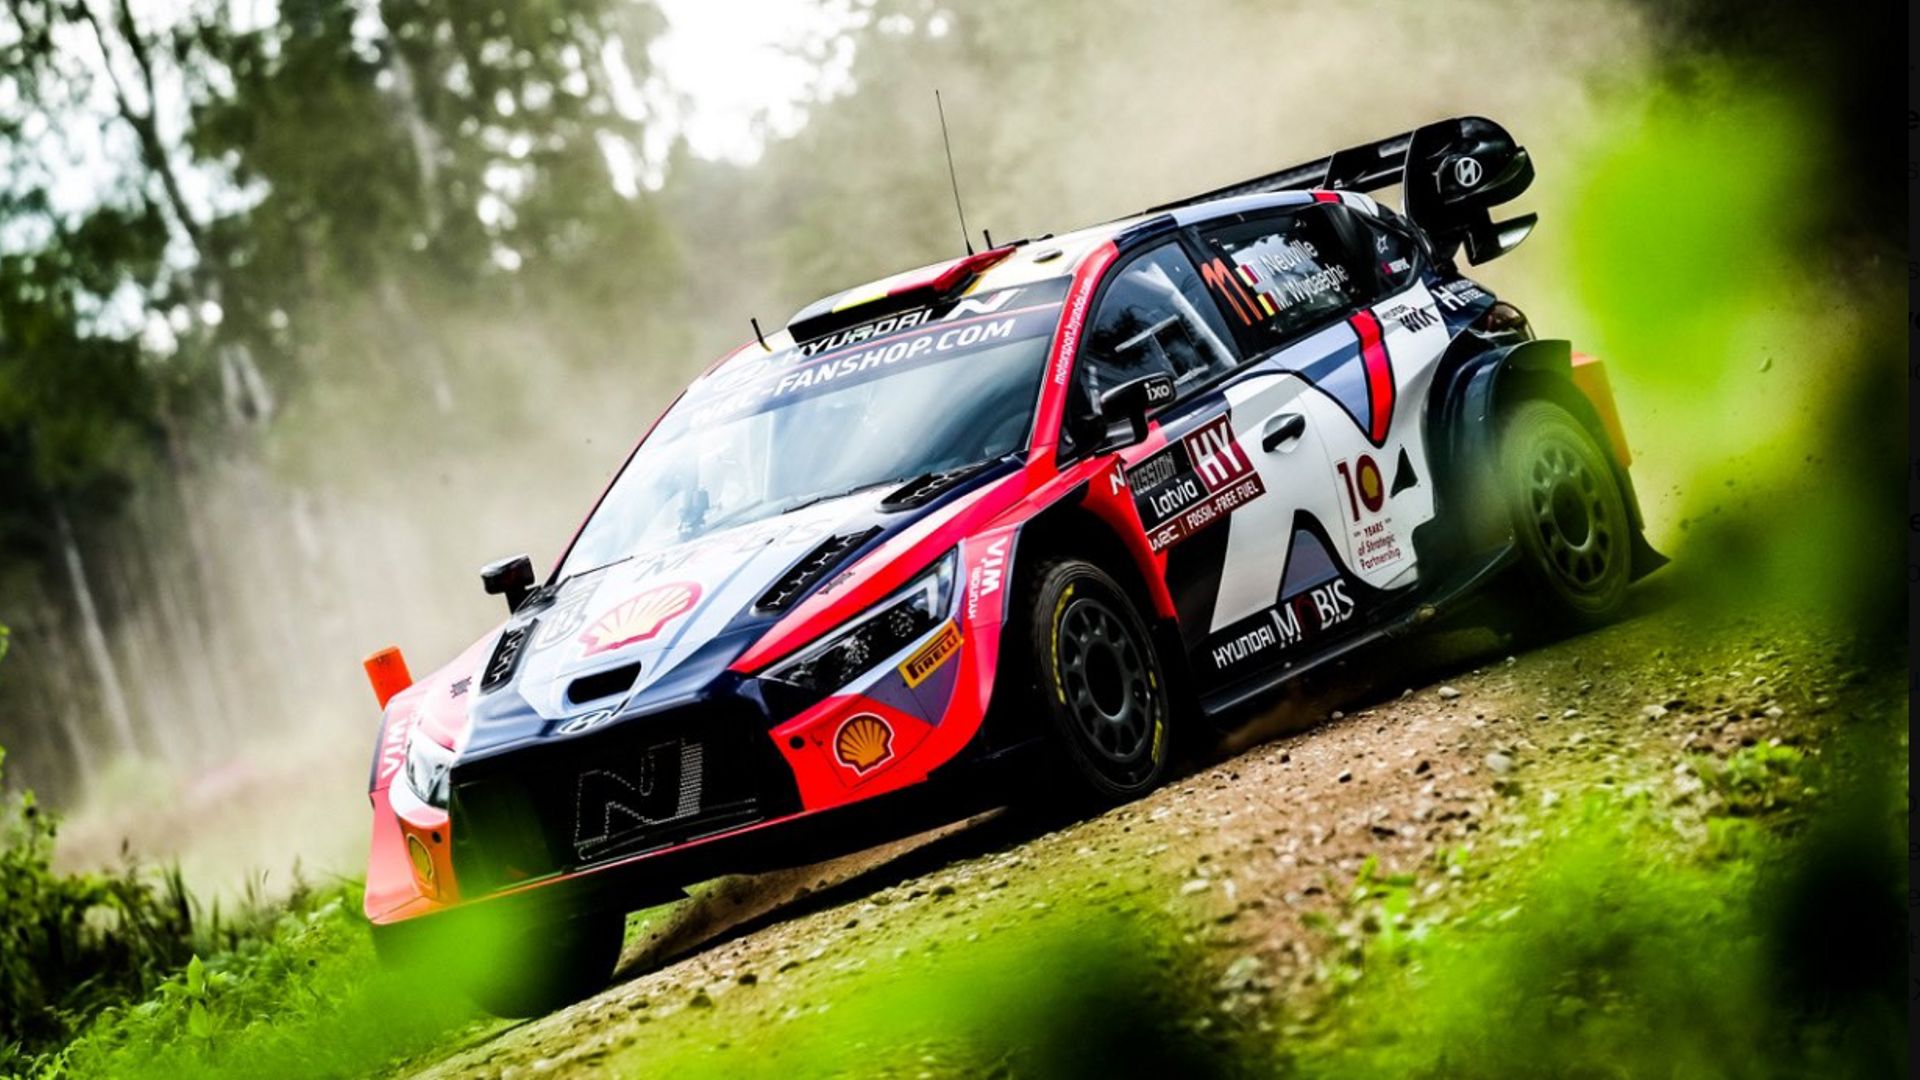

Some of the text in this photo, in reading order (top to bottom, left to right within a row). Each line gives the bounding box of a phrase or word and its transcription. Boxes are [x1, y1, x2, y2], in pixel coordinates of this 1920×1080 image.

[1260, 239, 1319, 275] Neuville
[1201, 257, 1264, 326] 11
[1283, 263, 1349, 304] Wydaeghe
[1055, 278, 1093, 385] motorsport.hyundai.com
[1143, 382, 1170, 401] ixo
[1190, 421, 1243, 486] HY
[1150, 478, 1199, 518] Latvia
[1186, 490, 1240, 530] FOSSIL-FREE
[1236, 479, 1260, 501] FUEL
[1360, 548, 1401, 570] Partnership
[968, 566, 982, 619] HYUNDAI
[1212, 578, 1355, 669] HYUNDAI MOBIS
[906, 628, 958, 680] PIRELLI
